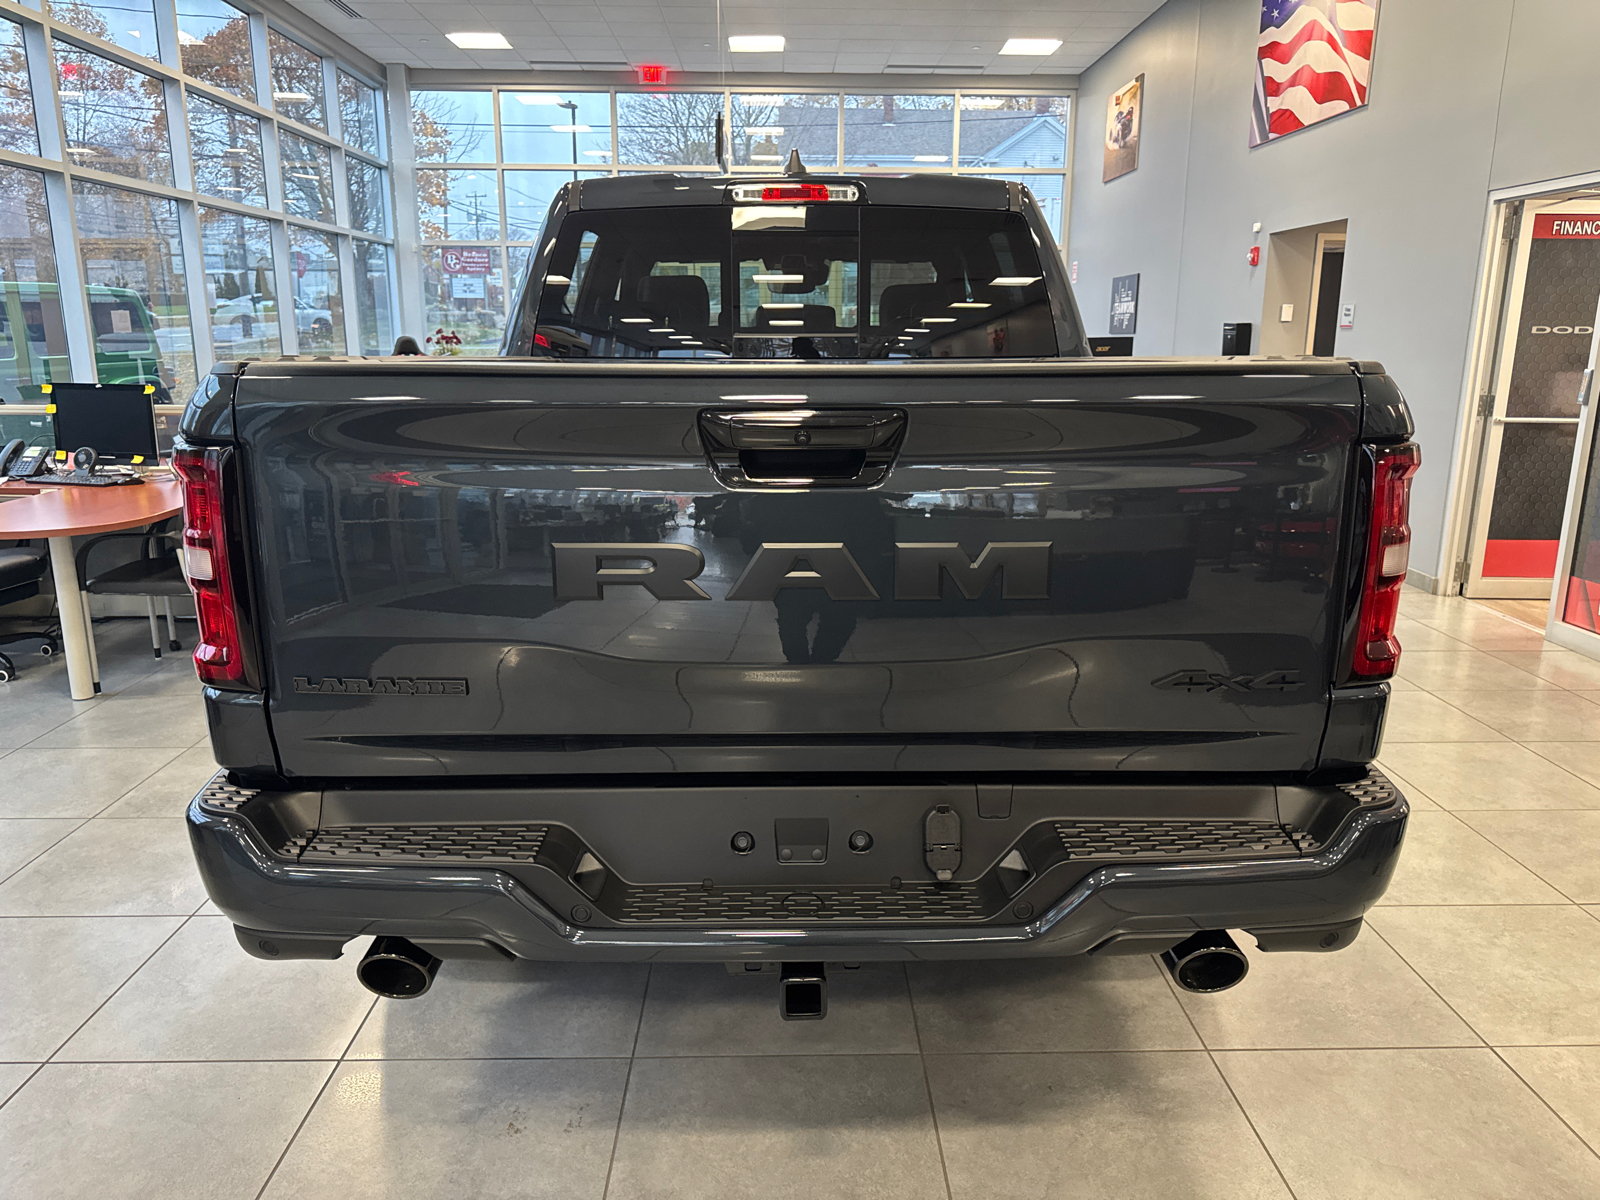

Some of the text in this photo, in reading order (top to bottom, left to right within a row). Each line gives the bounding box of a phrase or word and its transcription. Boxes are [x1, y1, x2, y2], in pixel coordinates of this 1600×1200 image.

[643, 67, 662, 82] EXIT
[1531, 325, 1593, 334] DOD
[551, 541, 1053, 601] RAM
[293, 676, 469, 696] LARAMIE
